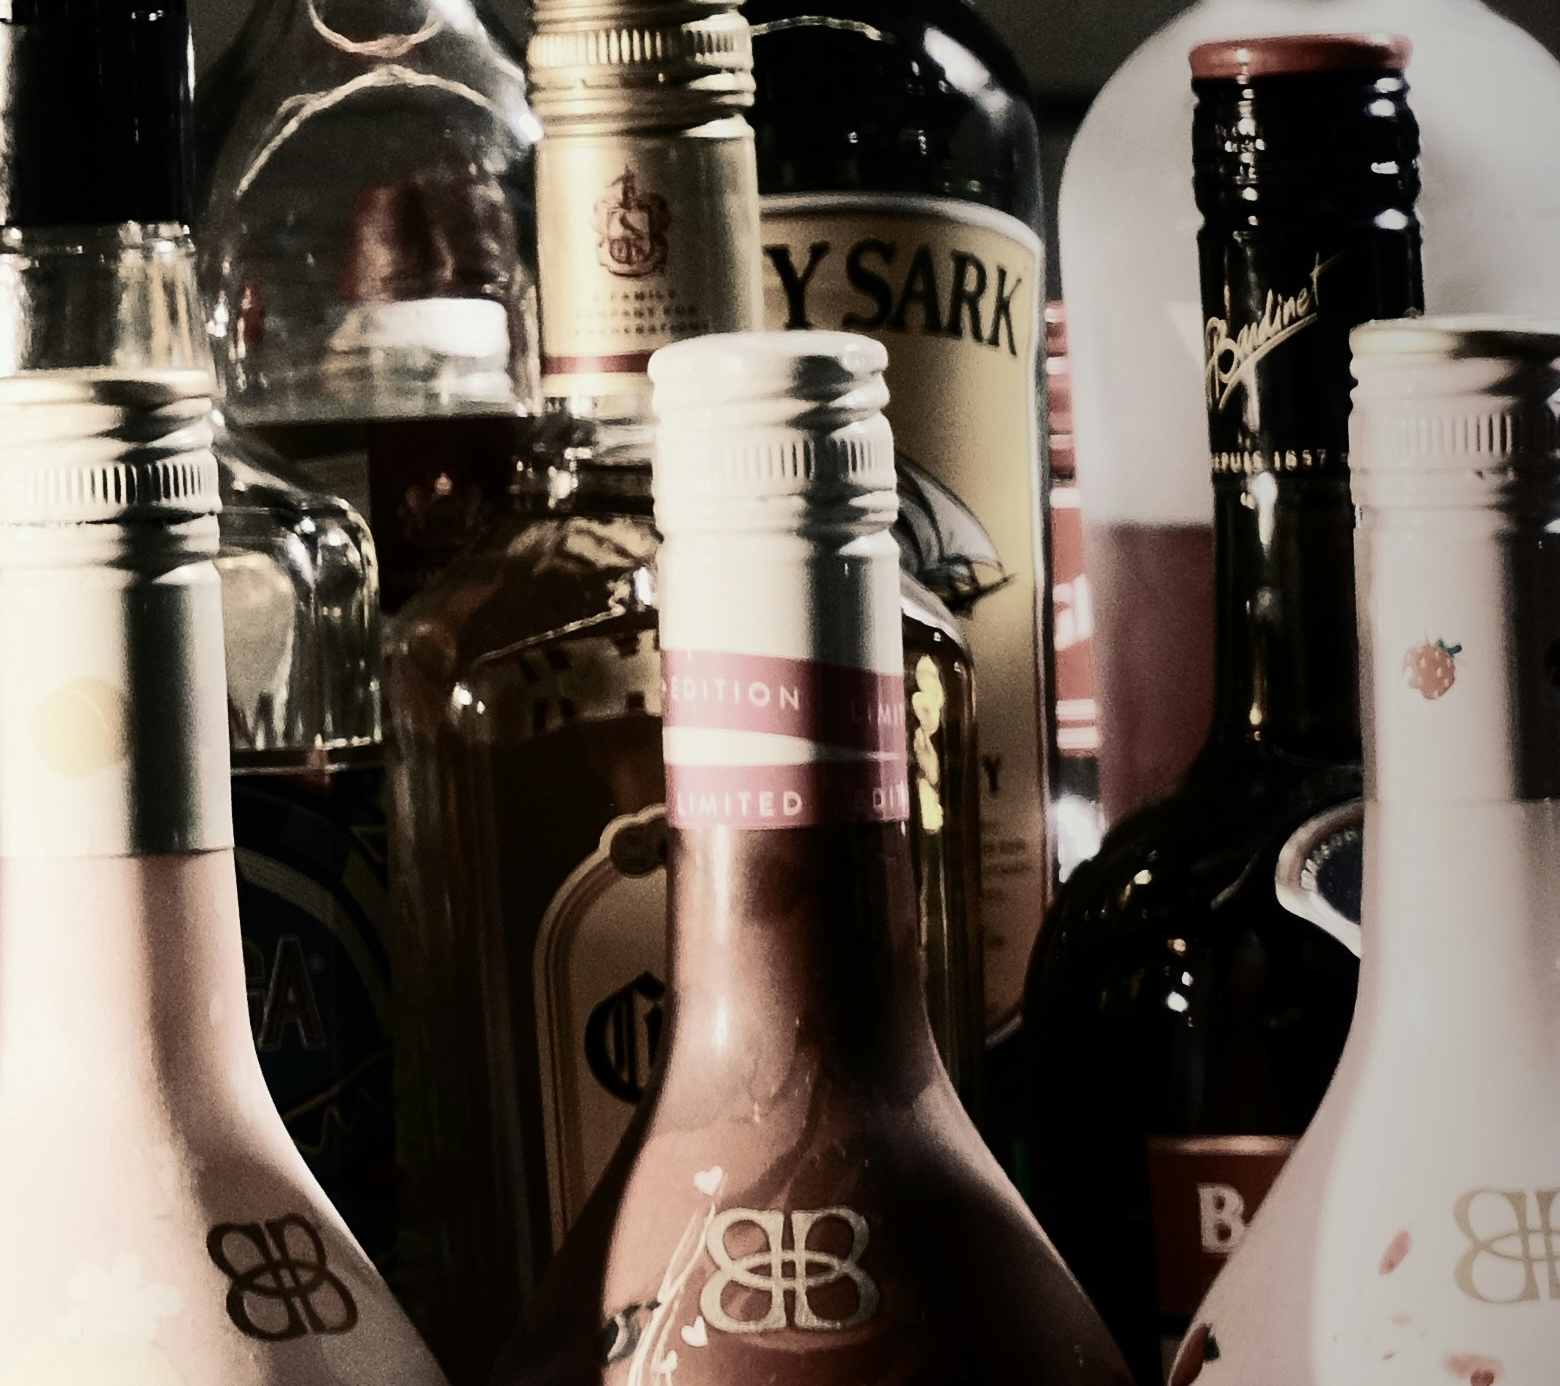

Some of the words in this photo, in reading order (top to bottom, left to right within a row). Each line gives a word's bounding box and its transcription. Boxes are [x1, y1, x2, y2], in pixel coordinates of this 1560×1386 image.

[842, 239, 1022, 357] SARK
[666, 676, 800, 711] EDITION
[677, 789, 804, 816] LIMITED
